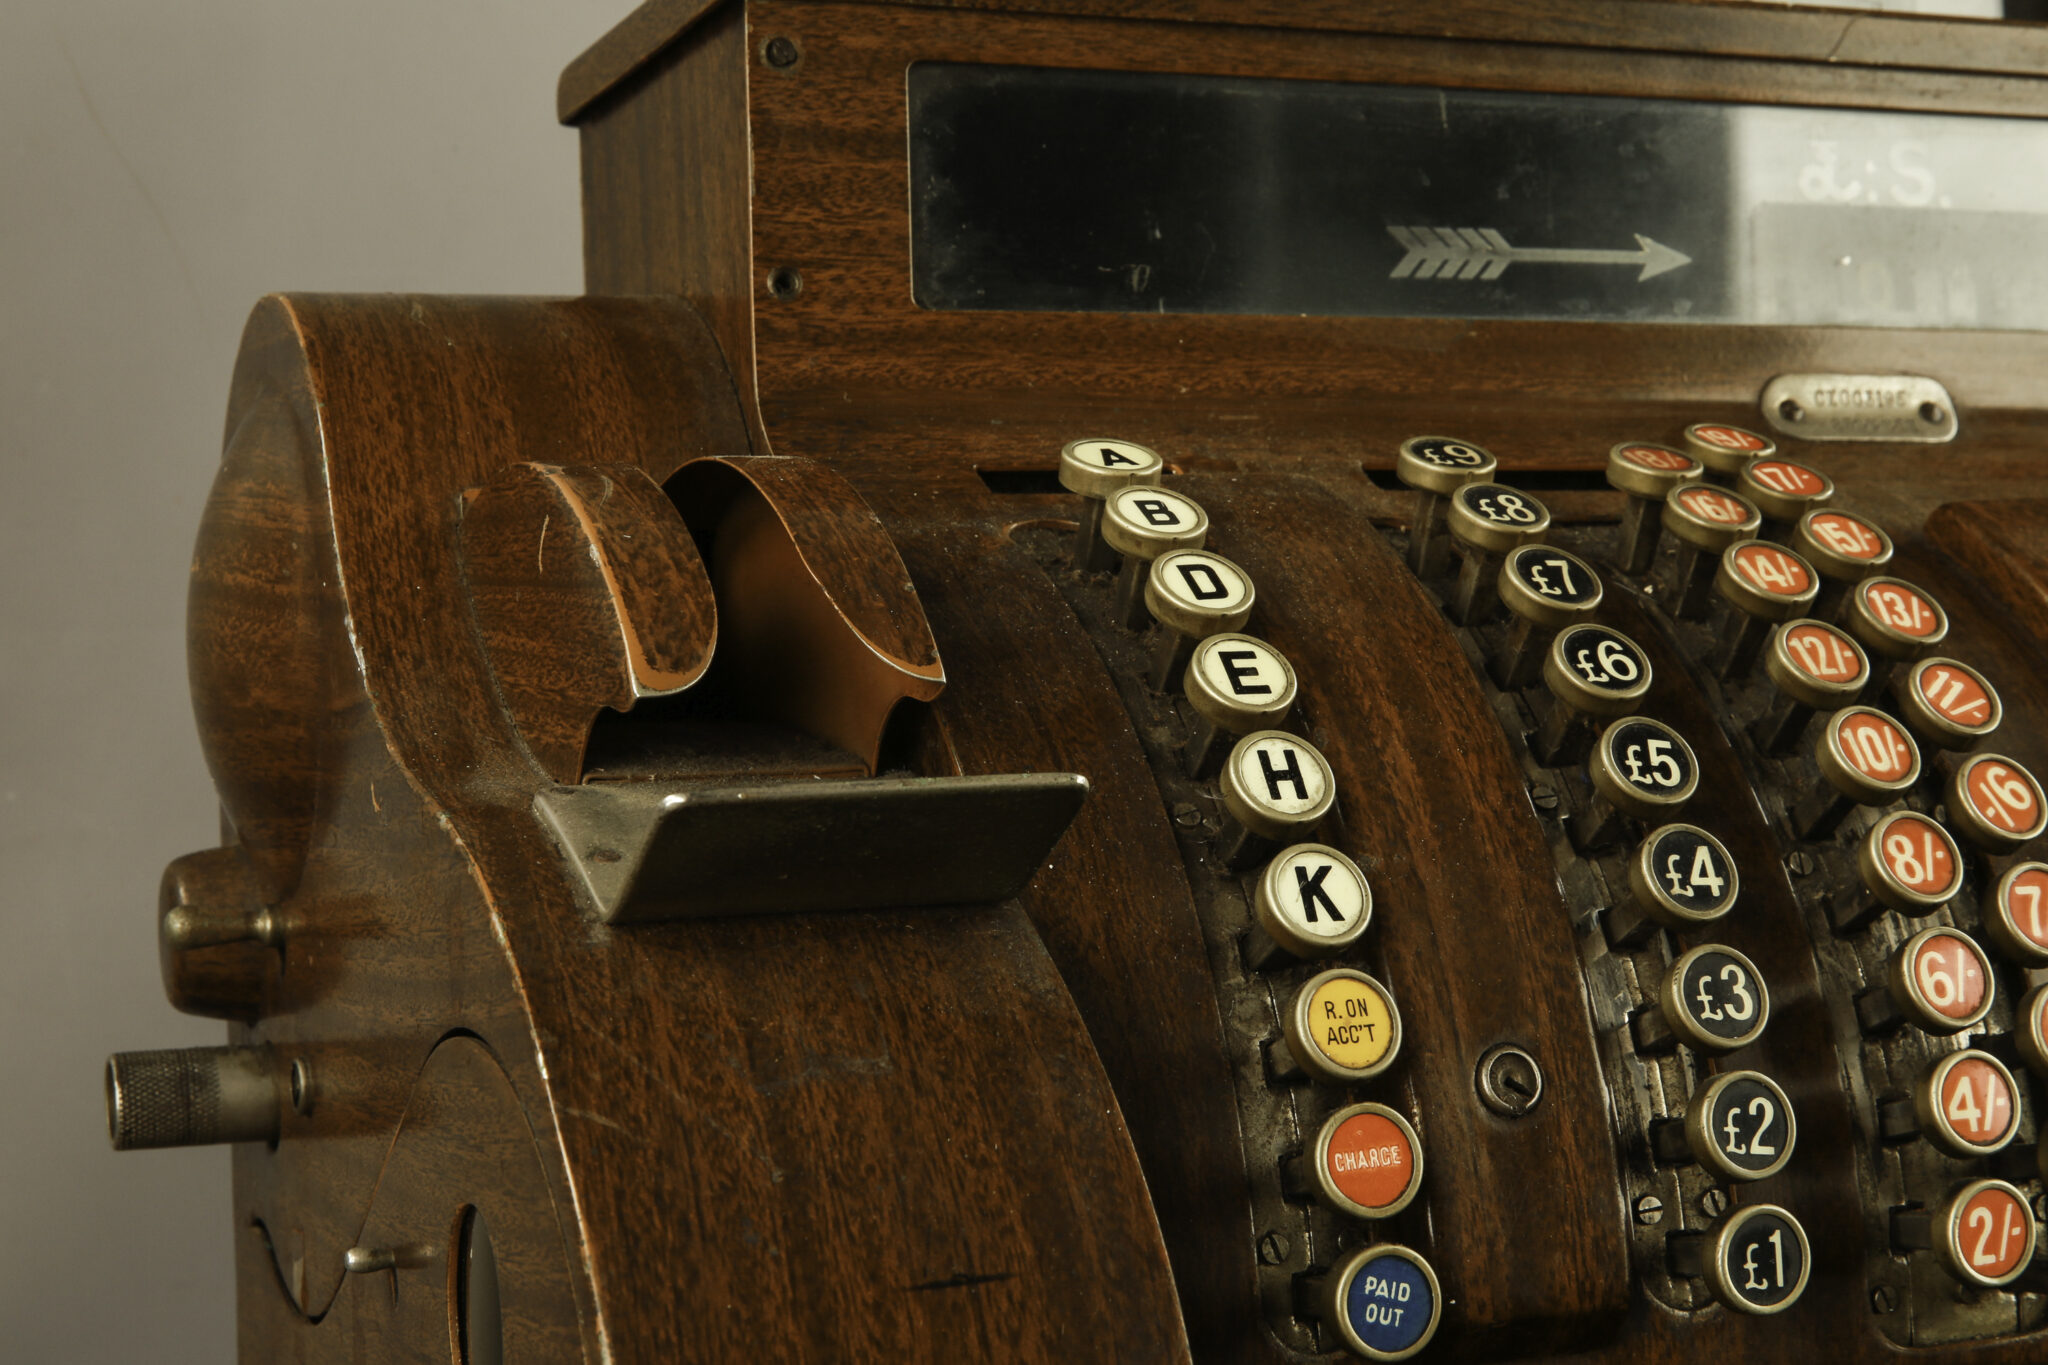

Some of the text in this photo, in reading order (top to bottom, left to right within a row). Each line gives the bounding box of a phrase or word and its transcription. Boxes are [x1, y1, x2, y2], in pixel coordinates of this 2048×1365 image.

[1100, 448, 1139, 466] A
[1424, 444, 1482, 466] £9
[1622, 449, 1683, 468] 18/-
[1694, 429, 1753, 448] 19/-
[1752, 467, 1810, 491] 17/-
[1133, 500, 1180, 525] B
[1479, 494, 1536, 523] £8
[1680, 494, 1743, 521] 16/-
[1811, 520, 1872, 554] 15/-
[1176, 564, 1229, 600] D
[1530, 560, 1577, 595] £7
[1737, 553, 1800, 589] 14/-
[1868, 590, 1931, 629] 13/-
[1218, 651, 1272, 695] E
[1576, 640, 1638, 683] £6
[1788, 635, 1852, 676] 12/-
[1926, 670, 1987, 718] 11/-
[1625, 739, 1681, 787] £5
[1841, 725, 1906, 773] 10/-
[1257, 749, 1309, 801] H
[1666, 846, 1724, 897] £4
[1887, 831, 1944, 884] 8/-
[1294, 865, 1346, 923] K
[1697, 964, 1753, 1021] £3
[1919, 947, 1975, 1006] 6/-
[1949, 1074, 2006, 1132] 4/-
[1723, 1096, 1776, 1156] £2
[1334, 1145, 1402, 1174] CHARGE
[1969, 1203, 2021, 1267] 2/-
[1743, 1229, 1785, 1291] £1
[1365, 1274, 1412, 1303] PAID
[1366, 1307, 1405, 1328] OUT
